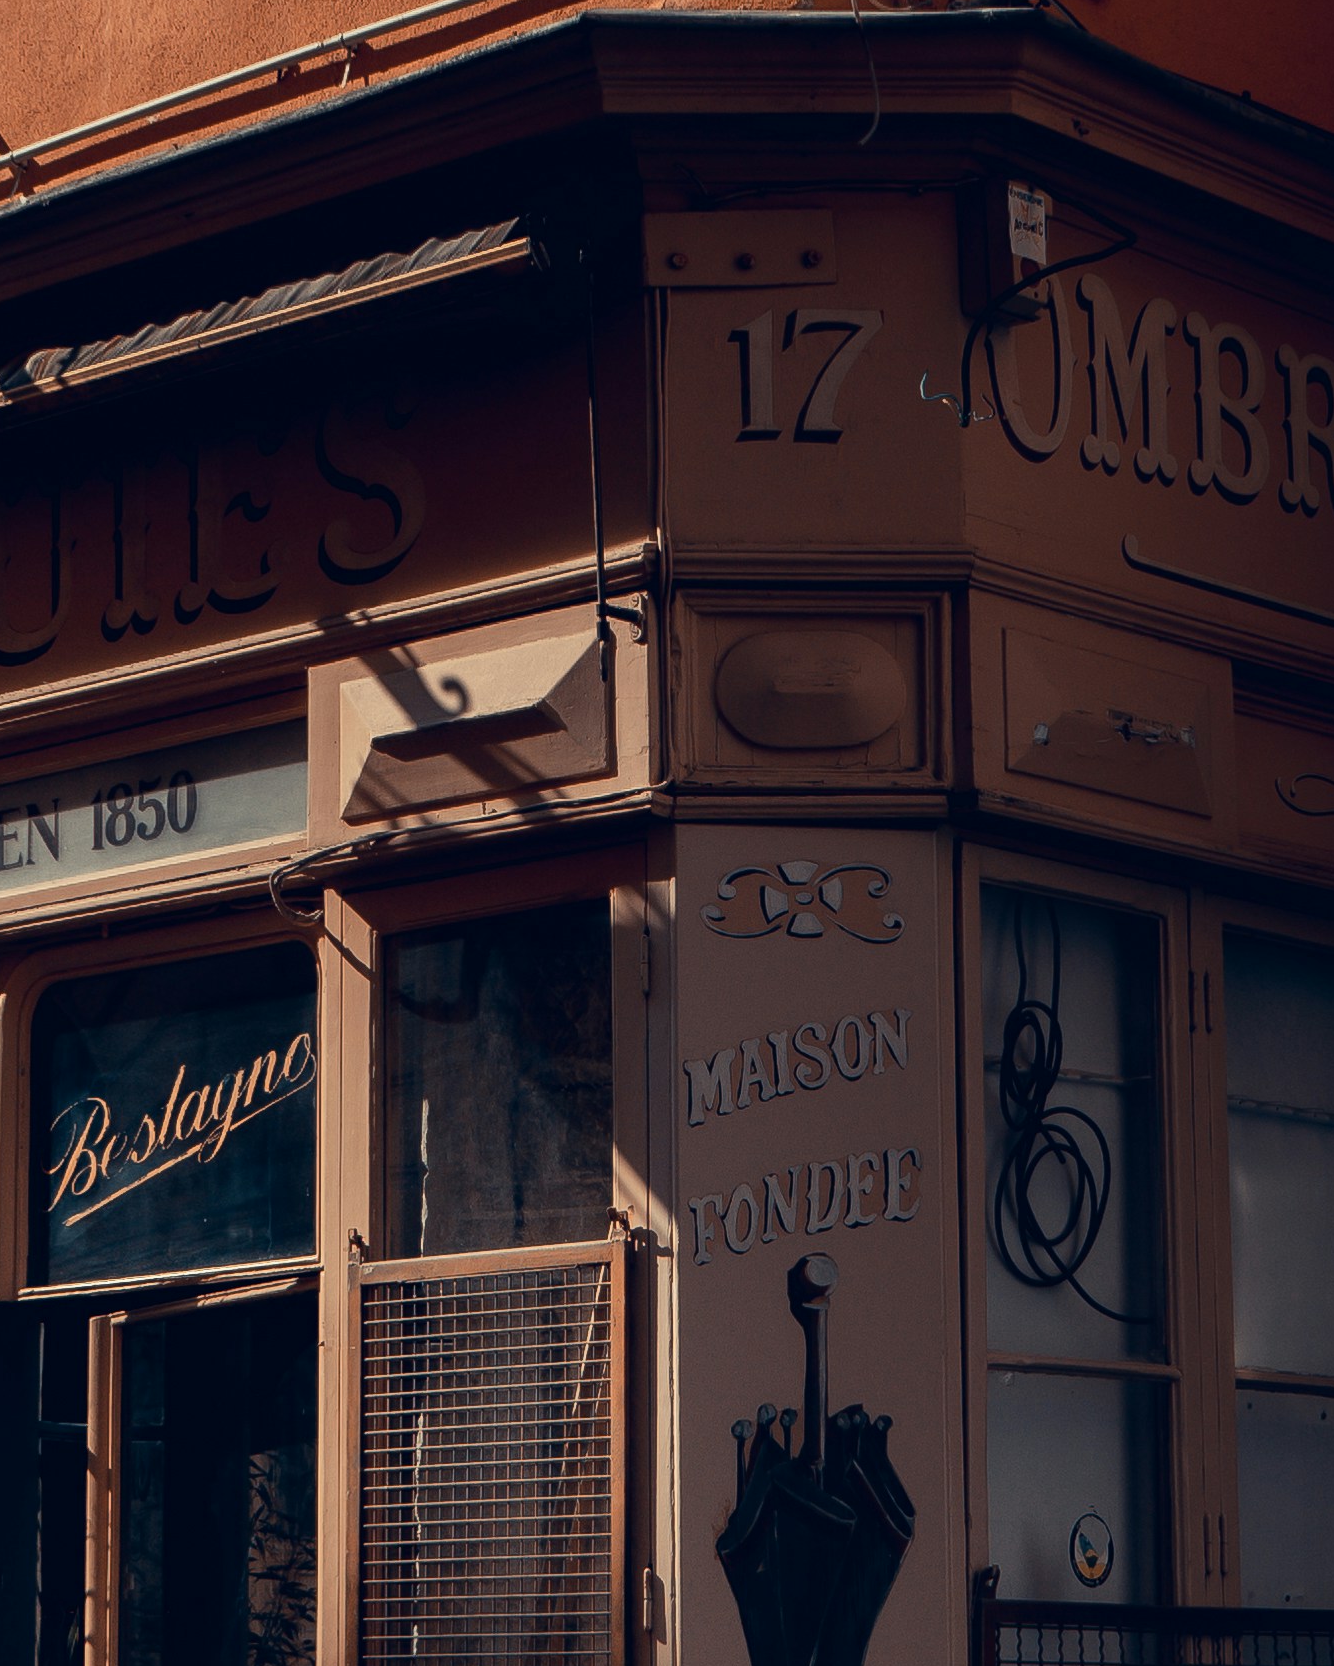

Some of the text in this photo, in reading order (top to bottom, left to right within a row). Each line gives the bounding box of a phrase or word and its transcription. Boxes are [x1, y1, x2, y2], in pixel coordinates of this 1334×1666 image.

[726, 307, 885, 444] 17
[91, 768, 199, 852] 1850
[683, 1007, 914, 1128] MAISON
[687, 1146, 923, 1266] FONDEE
